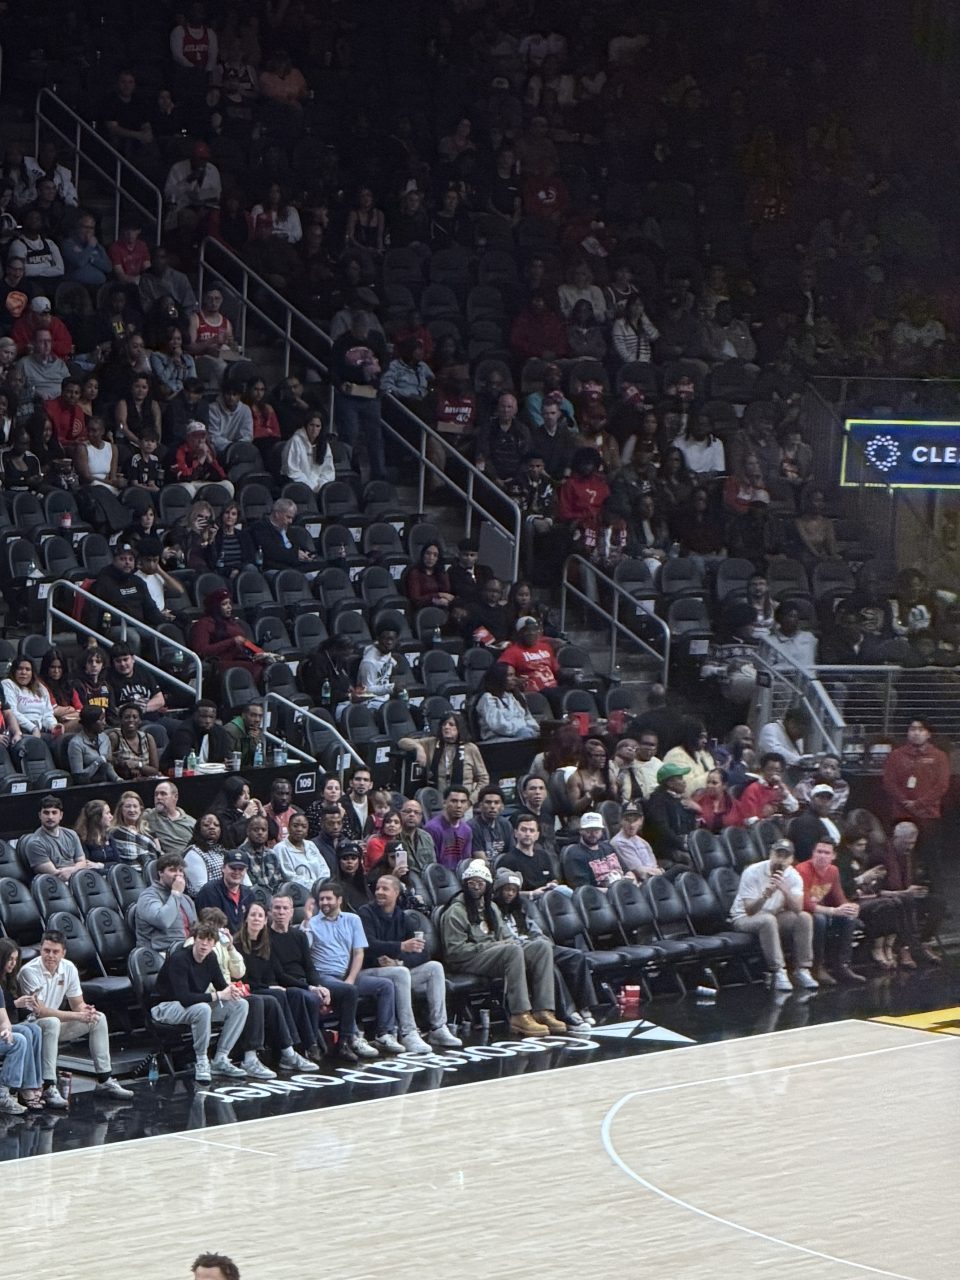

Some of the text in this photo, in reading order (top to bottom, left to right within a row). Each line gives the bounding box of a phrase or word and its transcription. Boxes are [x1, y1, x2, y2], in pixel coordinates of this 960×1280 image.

[912, 446, 960, 463] CLE
[299, 777, 313, 788] 109
[200, 1067, 402, 1104] Power
